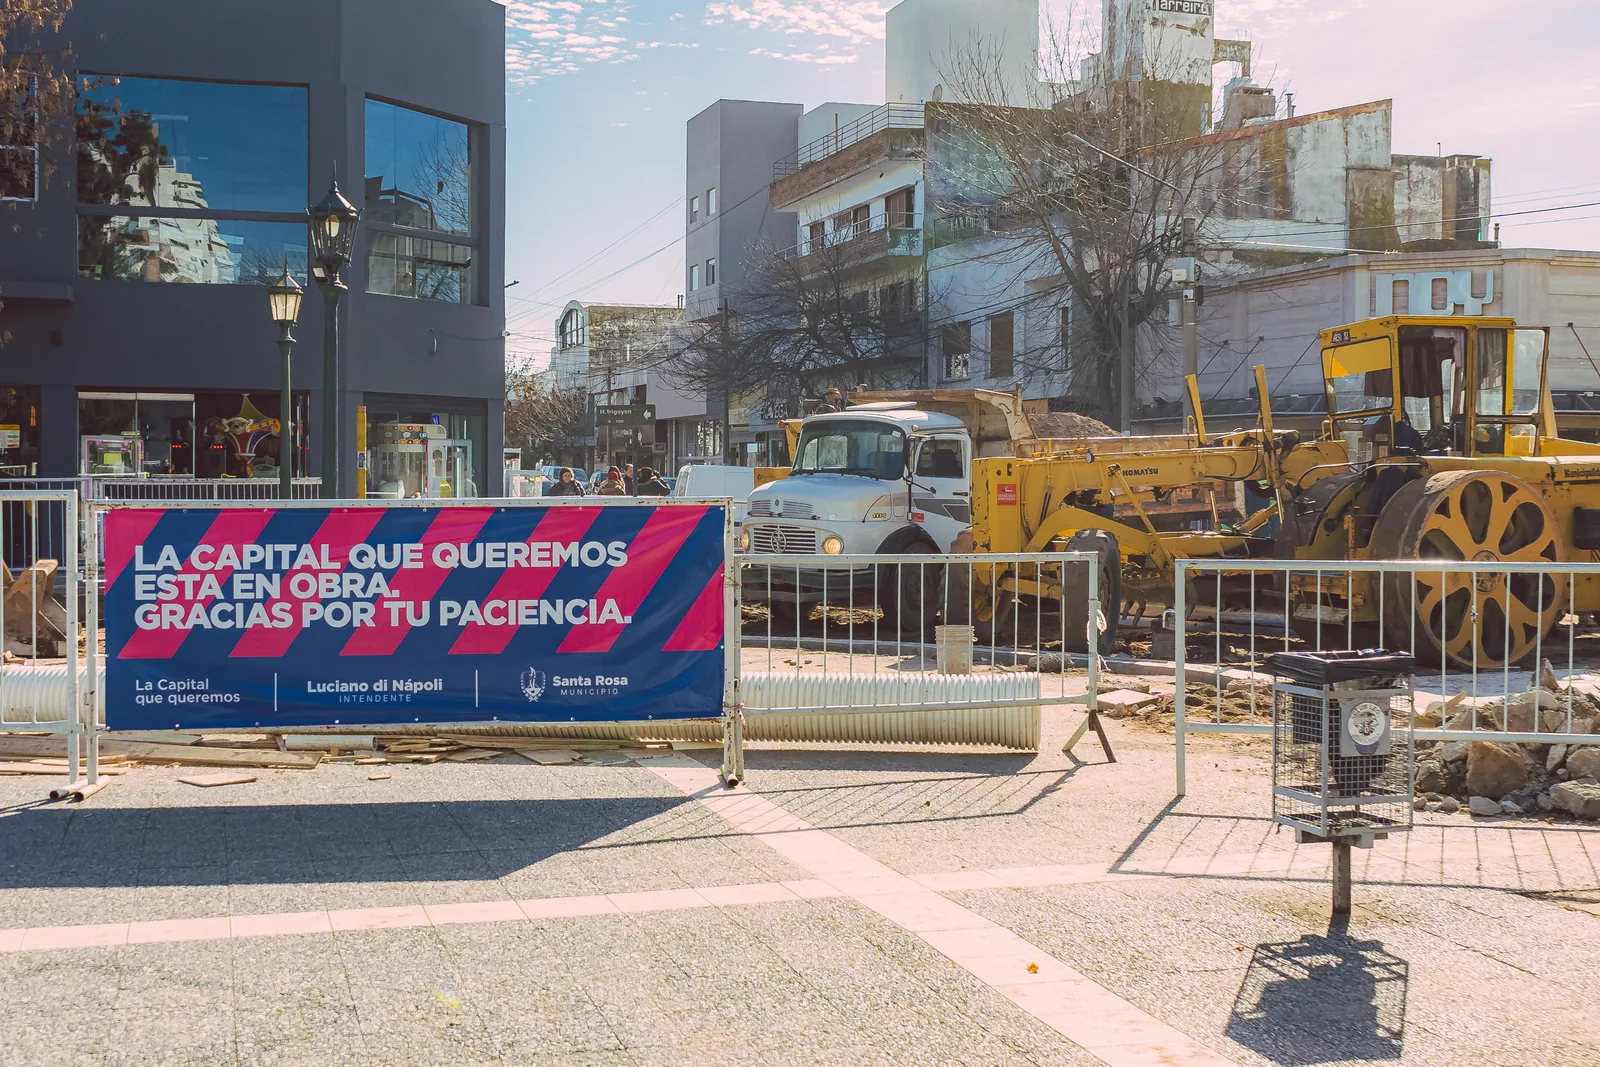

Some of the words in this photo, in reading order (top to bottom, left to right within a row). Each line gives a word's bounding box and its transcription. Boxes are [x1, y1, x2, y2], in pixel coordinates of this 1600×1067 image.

[1122, 466, 1159, 477] KOMATSU
[135, 545, 183, 571] LA
[191, 544, 341, 571] CAPITAL
[348, 543, 424, 571] QUE
[432, 541, 628, 569] QUEREMOS
[135, 573, 225, 600] ESTA
[233, 573, 281, 600] EN
[289, 572, 401, 600] OBRA.
[134, 601, 294, 630] GRACIAS
[302, 602, 376, 629] POR
[384, 601, 430, 628] TU
[440, 598, 632, 626] PACIENCIA.
[135, 679, 153, 691] La
[157, 678, 209, 693] Capital
[307, 681, 369, 693] Luciano
[373, 680, 388, 693] di
[393, 678, 443, 695] Nápoli
[552, 675, 592, 687] Santa
[595, 675, 628, 686] Rosa
[338, 694, 412, 703] INTENDENTE
[560, 688, 619, 697] MUNICIPIO
[135, 694, 163, 708] que
[168, 693, 240, 707] queremos
